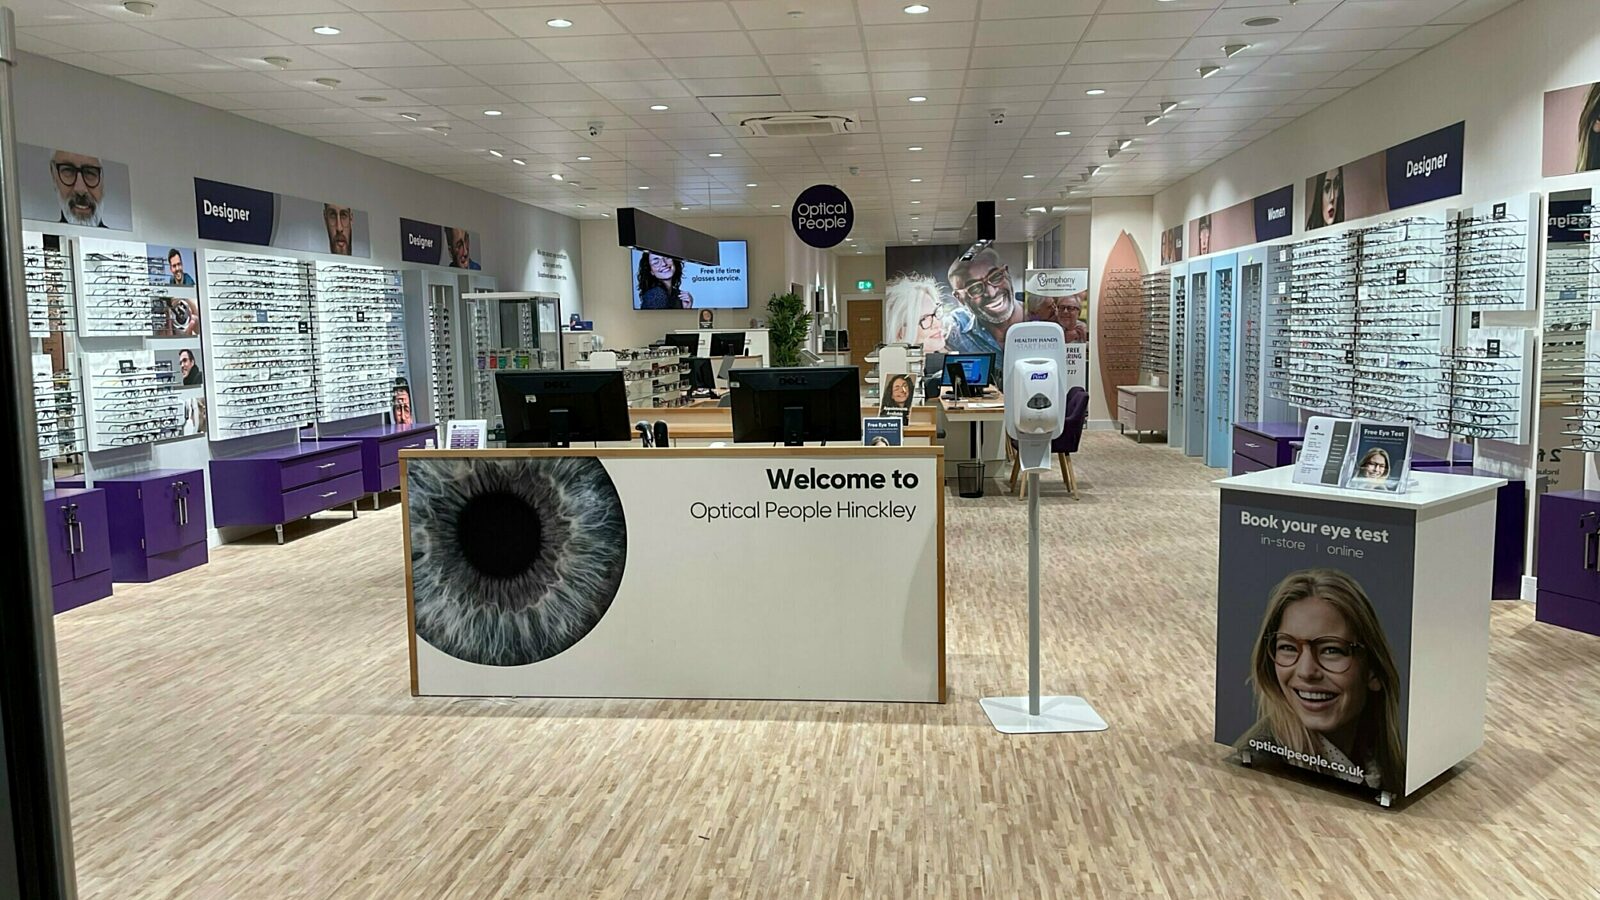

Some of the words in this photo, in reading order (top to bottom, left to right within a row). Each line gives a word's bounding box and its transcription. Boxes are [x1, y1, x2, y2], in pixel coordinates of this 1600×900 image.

[1406, 153, 1448, 178] Designer
[203, 199, 250, 223] Designer
[797, 202, 847, 219] Optical
[1267, 207, 1286, 221] Women
[798, 216, 847, 232] People
[408, 233, 434, 249] Designer
[691, 275, 716, 283] glasses
[716, 275, 741, 283] service.
[700, 267, 714, 275] Free
[715, 267, 725, 275] life
[726, 267, 741, 275] time
[1066, 346, 1080, 354] FREE
[778, 376, 808, 385] DELL
[1364, 428, 1378, 436] Free
[1378, 429, 1390, 437] Eye
[766, 467, 886, 490] Welcome
[892, 469, 919, 490] to
[690, 500, 760, 522] Optical
[765, 500, 833, 522] People
[836, 500, 917, 522] Hinckley
[1240, 511, 1279, 530] Book
[1281, 519, 1318, 534] your
[1320, 524, 1351, 540] eye
[1354, 526, 1389, 543] test
[1260, 534, 1306, 551] in-store
[1327, 545, 1364, 559] online
[1249, 739, 1364, 778] opticalpeople.co.uk
